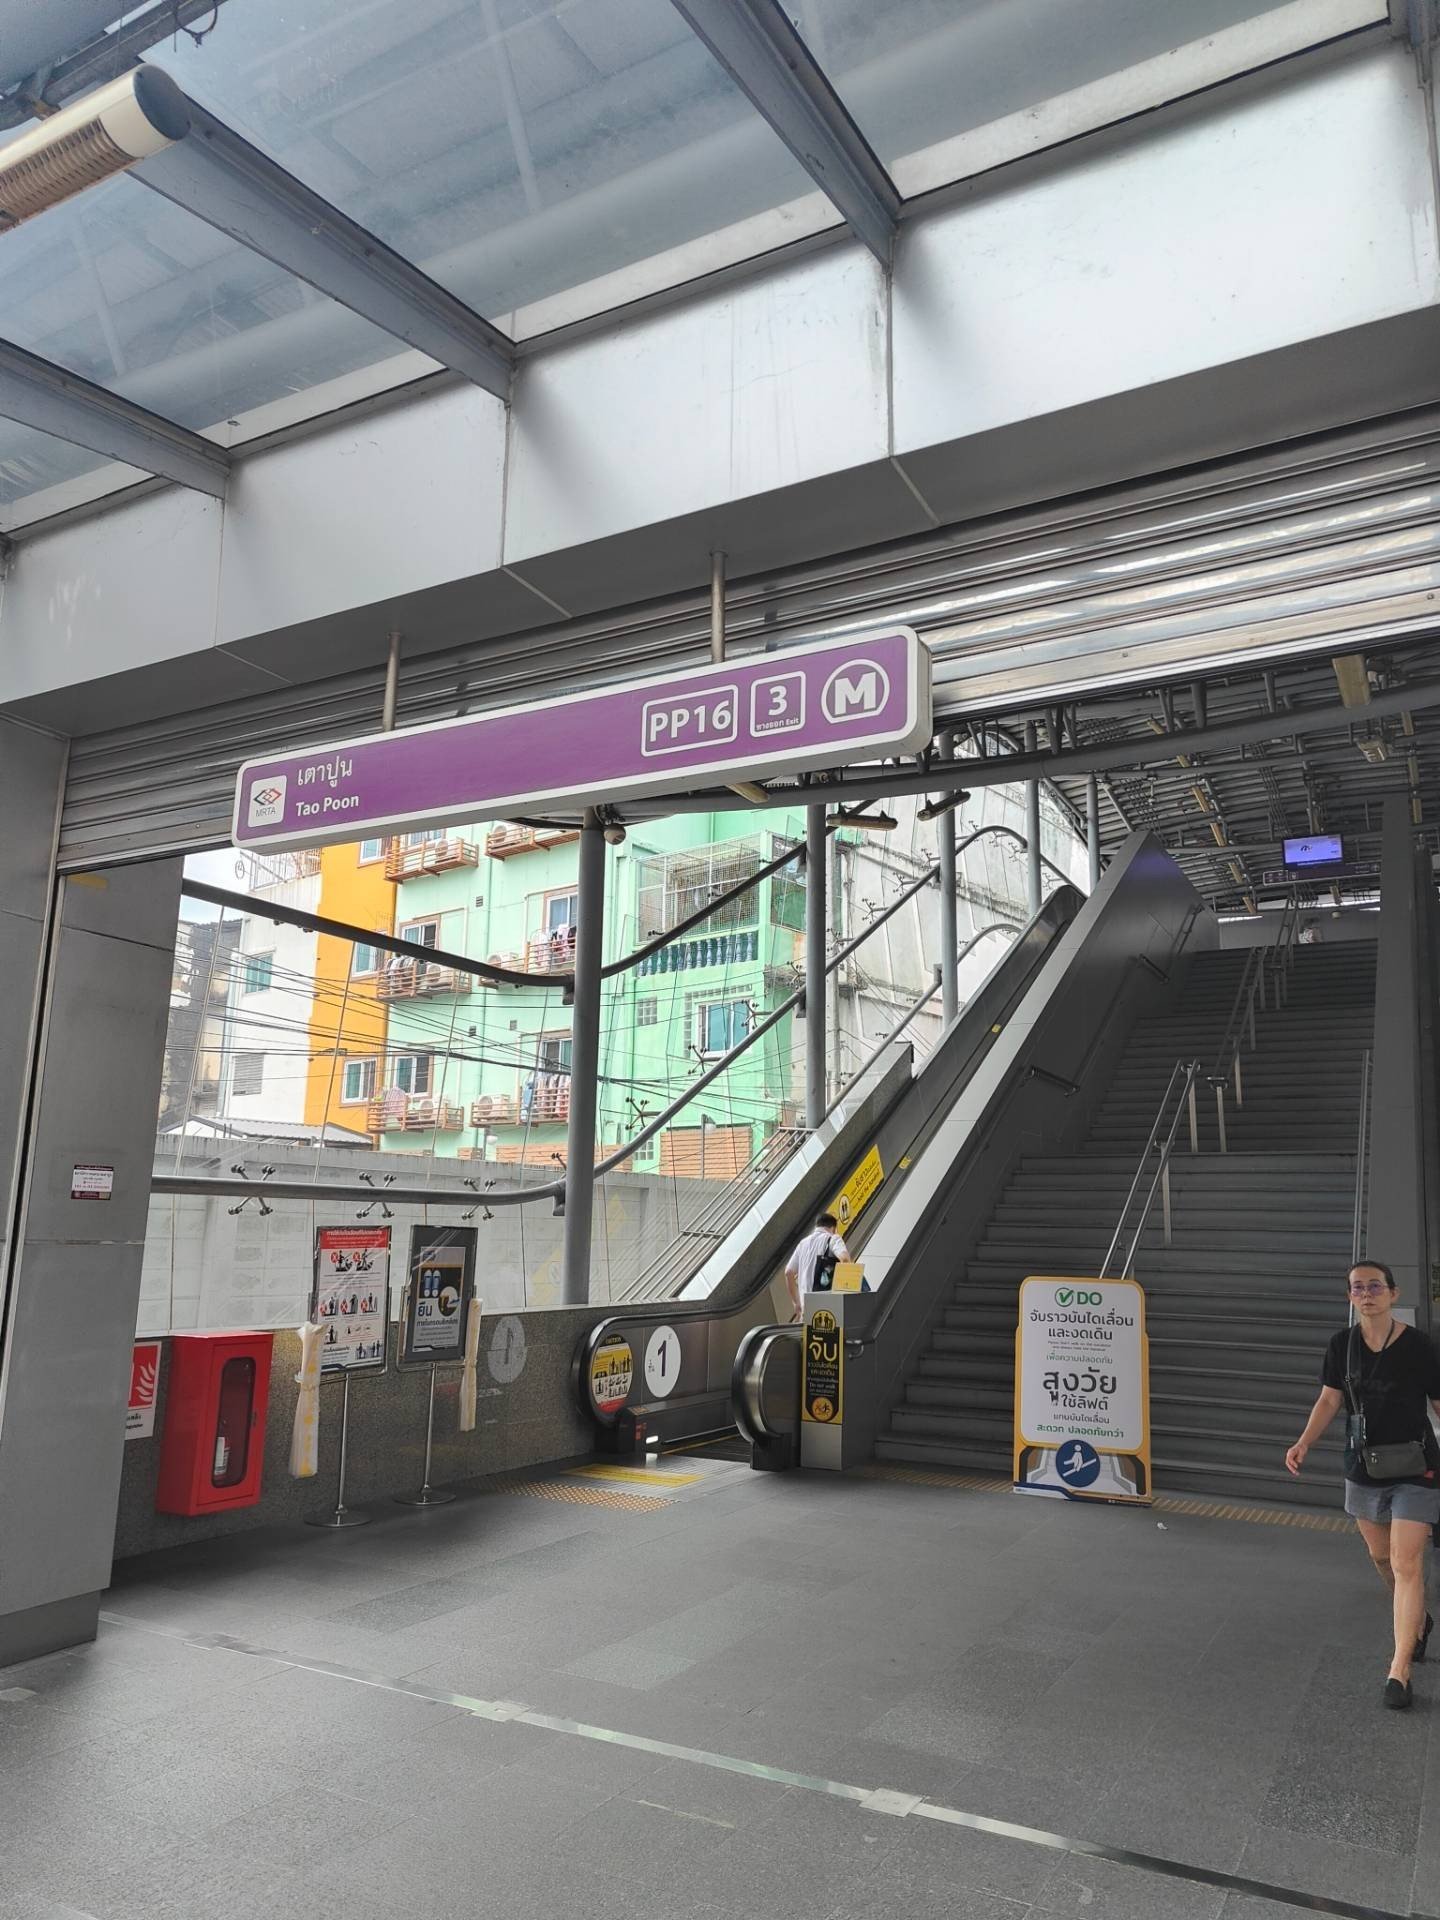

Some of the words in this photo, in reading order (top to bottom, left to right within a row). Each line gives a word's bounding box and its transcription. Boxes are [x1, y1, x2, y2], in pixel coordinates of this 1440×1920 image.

[767, 684, 788, 716] 3
[833, 671, 877, 716] M
[649, 700, 732, 743] PP16
[297, 755, 353, 788] เตาปูน
[255, 806, 276, 817] MRTA
[295, 801, 320, 817] Tao
[322, 794, 360, 812] Poon
[1076, 1291, 1103, 1306] DO
[1030, 1308, 1134, 1327] จับราวบันไดเลื่อน
[1048, 1327, 1113, 1341] และงดเดิน
[657, 1339, 667, 1377] 1
[808, 1334, 838, 1362] จับ
[1043, 1366, 1117, 1403] สูงวัย
[1061, 1393, 1109, 1411] ใช้ลิฟต์
[1036, 1424, 1065, 1434] สะดวก
